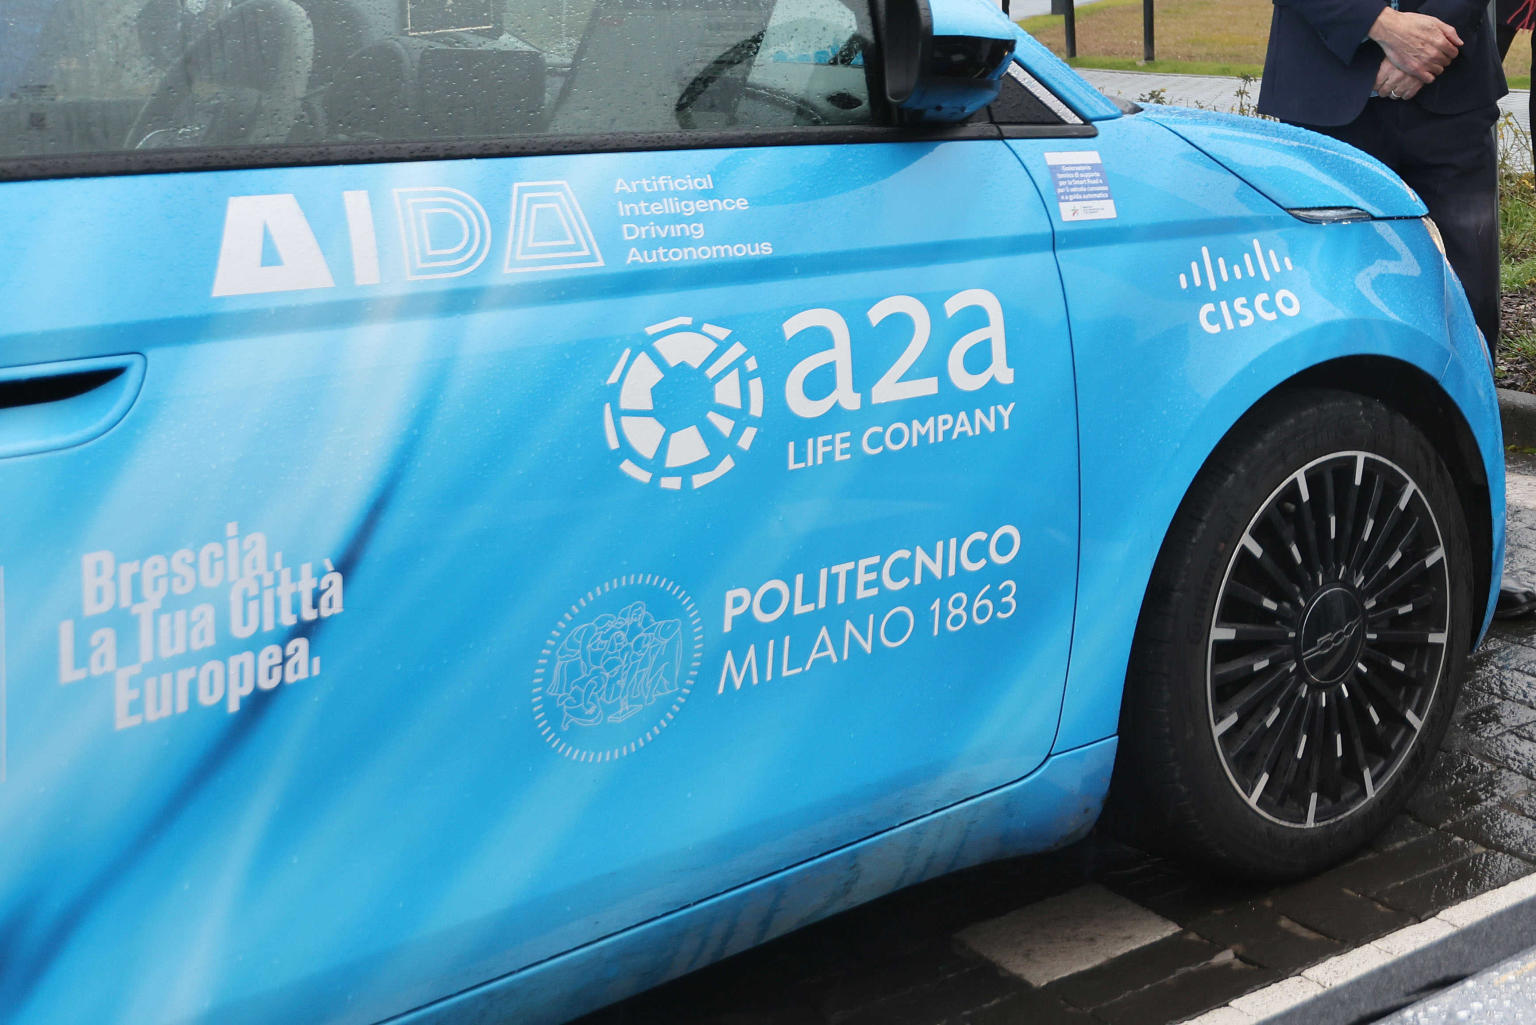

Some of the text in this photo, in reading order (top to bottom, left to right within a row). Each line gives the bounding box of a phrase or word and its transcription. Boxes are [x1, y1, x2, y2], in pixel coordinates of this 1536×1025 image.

[614, 174, 714, 194] Artificial
[617, 197, 750, 217] Intelligence
[211, 180, 606, 297] AIDA
[622, 222, 705, 240] Driving
[626, 241, 774, 264] Autonomous
[782, 288, 1015, 418] a2a
[788, 402, 1016, 470] LIFE COMPANY
[59, 558, 344, 685] La Tua Città
[723, 524, 1021, 633] POLITECNICO
[717, 579, 1018, 695] MILANO 1863
